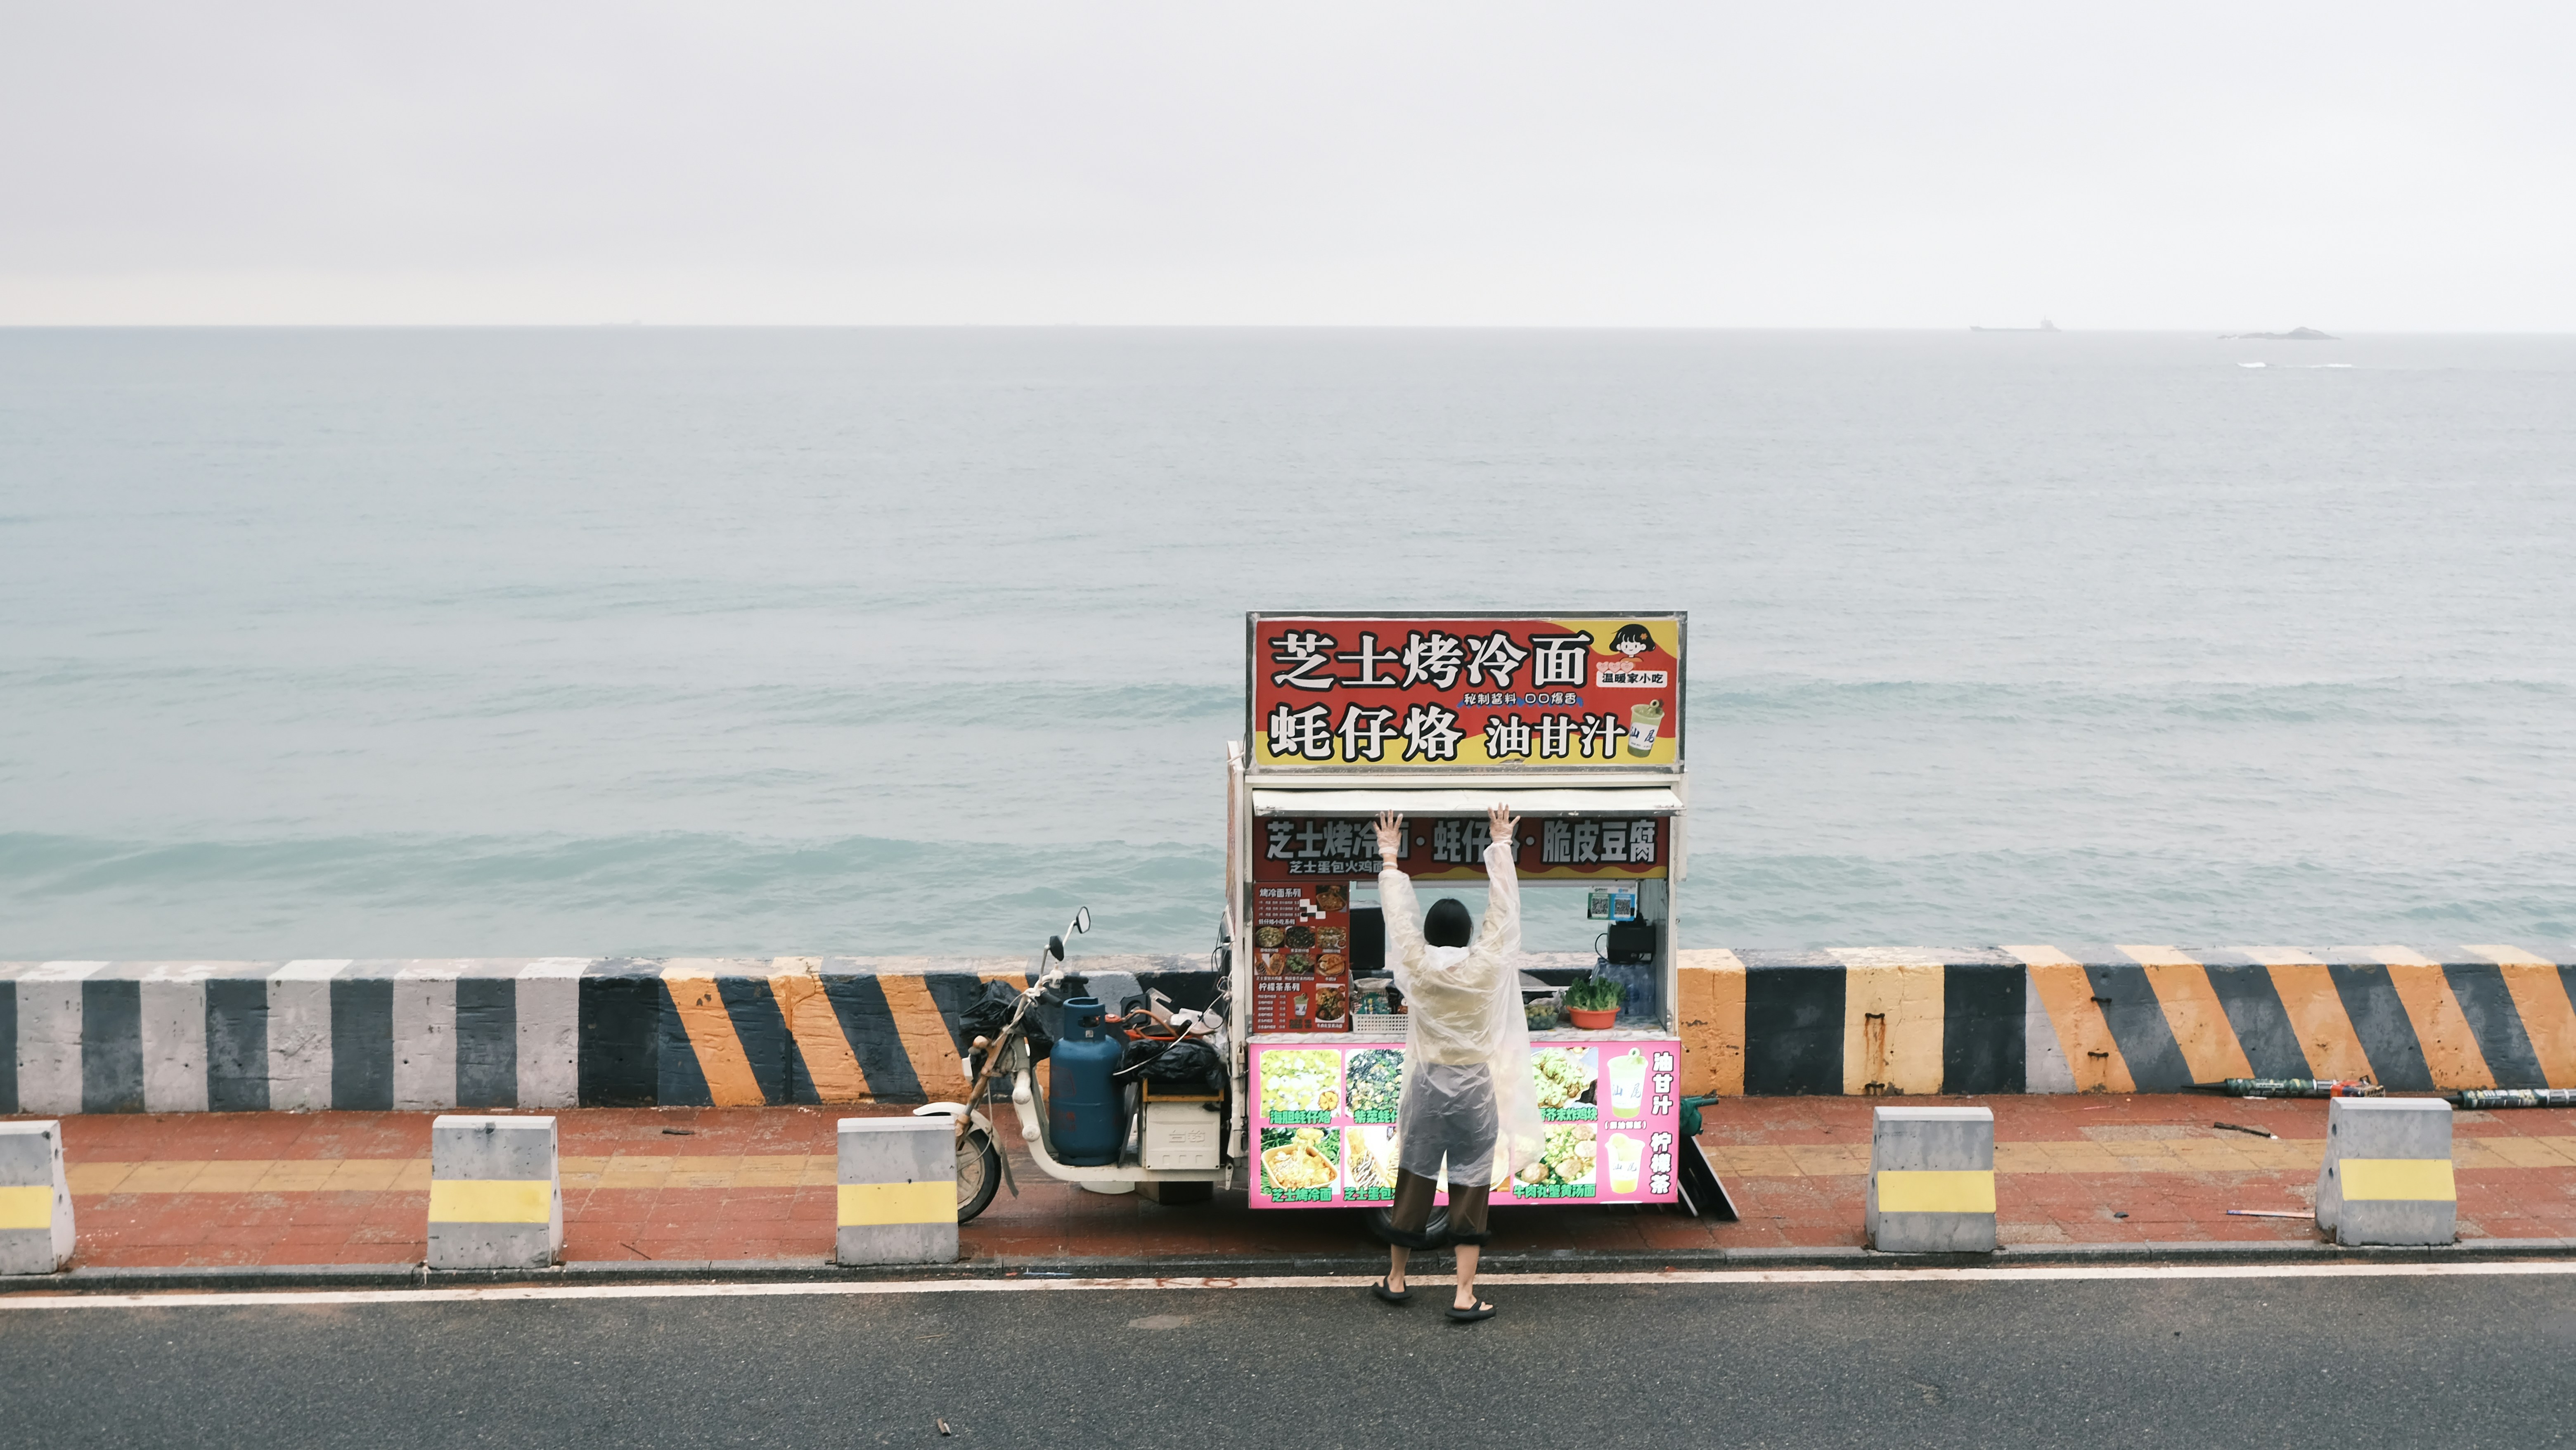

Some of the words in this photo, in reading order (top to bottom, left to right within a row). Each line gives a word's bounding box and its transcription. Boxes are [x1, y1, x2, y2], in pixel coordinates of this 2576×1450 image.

[1271, 632, 1591, 689] 芝士烤冷面
[1601, 673, 1664, 684] 温暖家小吃
[1270, 704, 1463, 759] 蚝仔烙
[1487, 714, 1627, 757] 油甘汁
[1433, 820, 1520, 862] 蚝仔
[1543, 819, 1655, 862] 脆皮豆腐
[1259, 888, 1301, 898] 烤冷面系列
[1652, 1052, 1674, 1116] 油甘汁
[1270, 1110, 1332, 1124] 海胆蚝仔烙
[1649, 1131, 1672, 1194] 柠檬茶
[1271, 1187, 1332, 1202] 芝士烤冷面
[1344, 1187, 1396, 1201] 芝士蛋包
[1513, 1183, 1596, 1199] 牛肉丸蟹黄汤面
